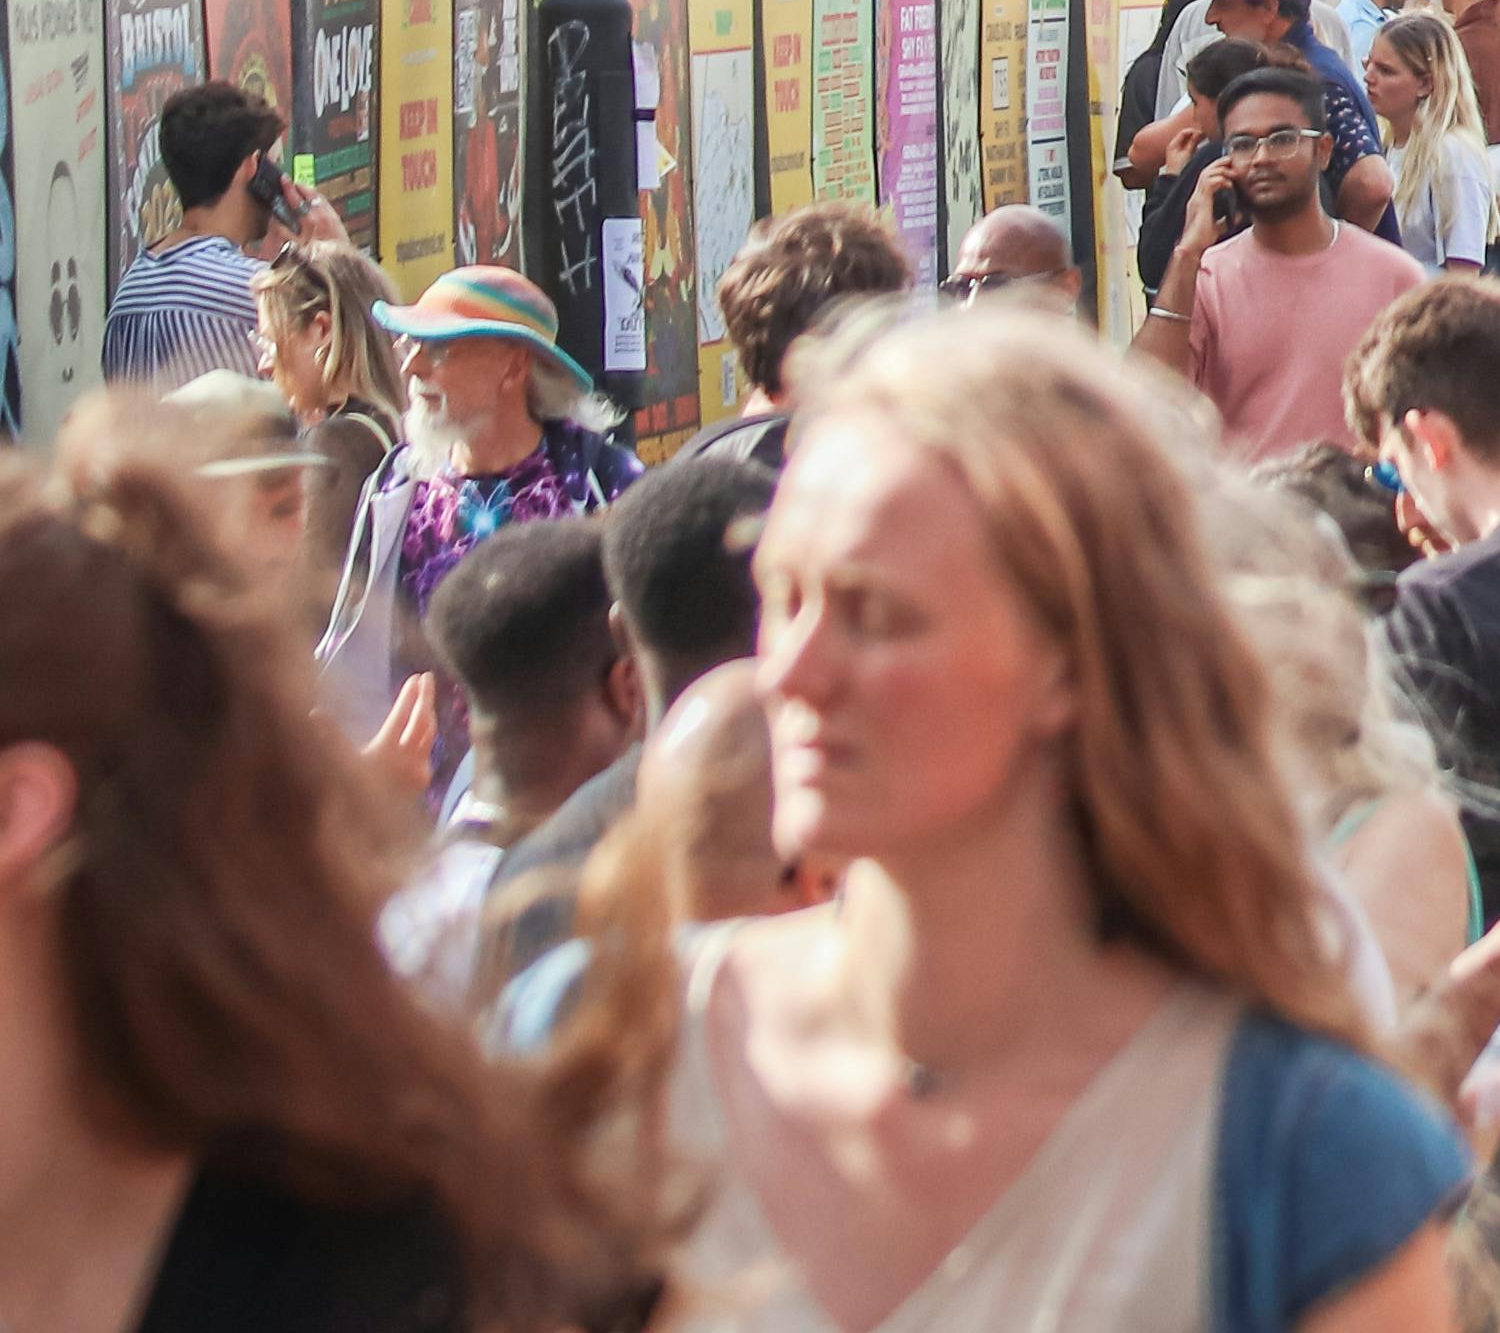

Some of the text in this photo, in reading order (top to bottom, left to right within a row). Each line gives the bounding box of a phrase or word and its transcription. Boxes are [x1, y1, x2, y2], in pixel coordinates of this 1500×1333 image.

[120, 3, 196, 92] BRISTOL
[400, 100, 427, 141] KEEP
[401, 148, 438, 192] TOUCH
